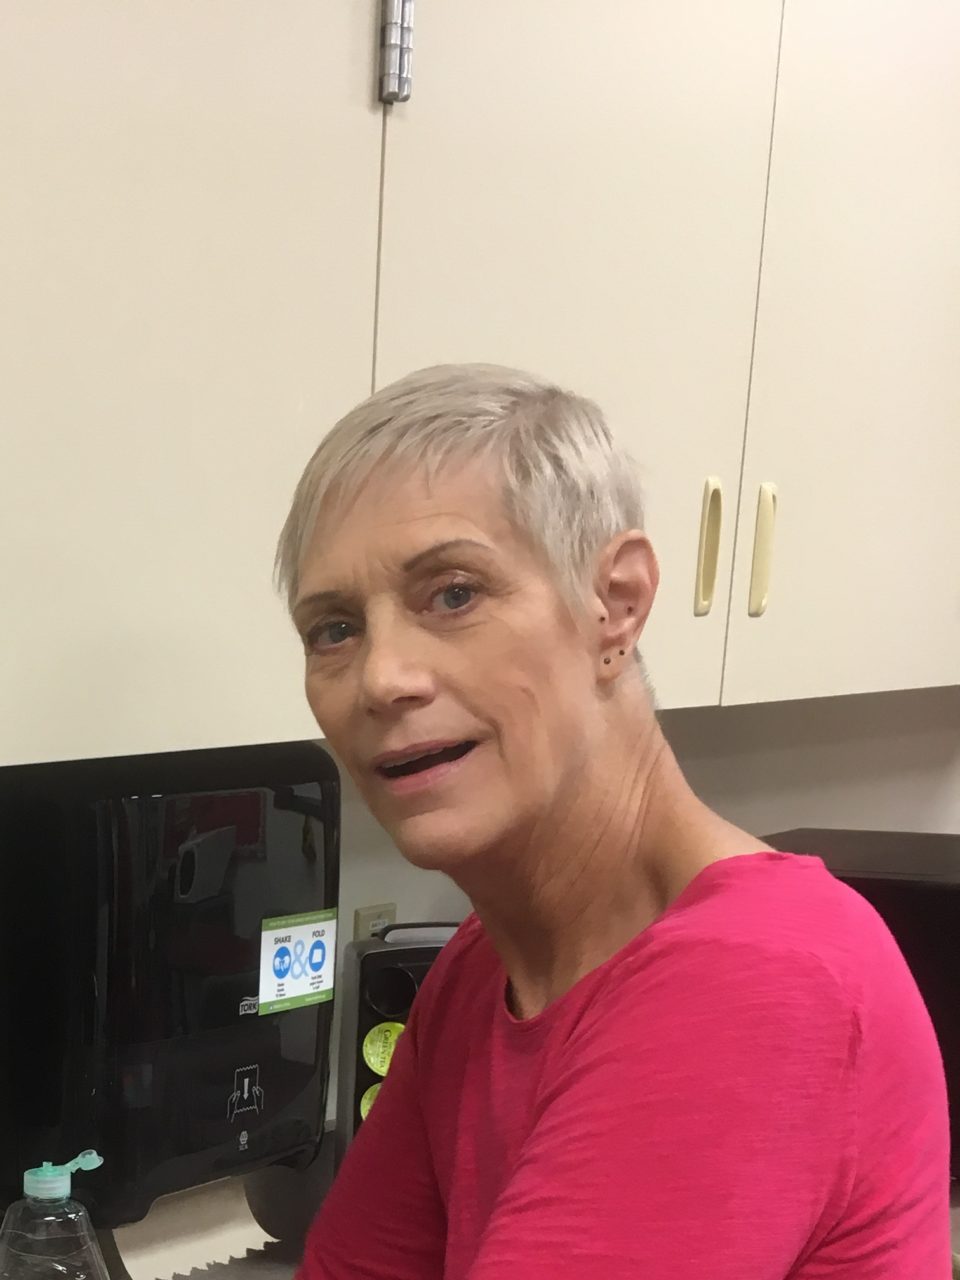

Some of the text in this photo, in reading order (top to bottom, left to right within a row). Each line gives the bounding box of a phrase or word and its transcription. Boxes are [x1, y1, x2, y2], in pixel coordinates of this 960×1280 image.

[274, 935, 292, 945] SHAKE
[312, 929, 326, 938] FOLD
[240, 1002, 258, 1013] TORK
